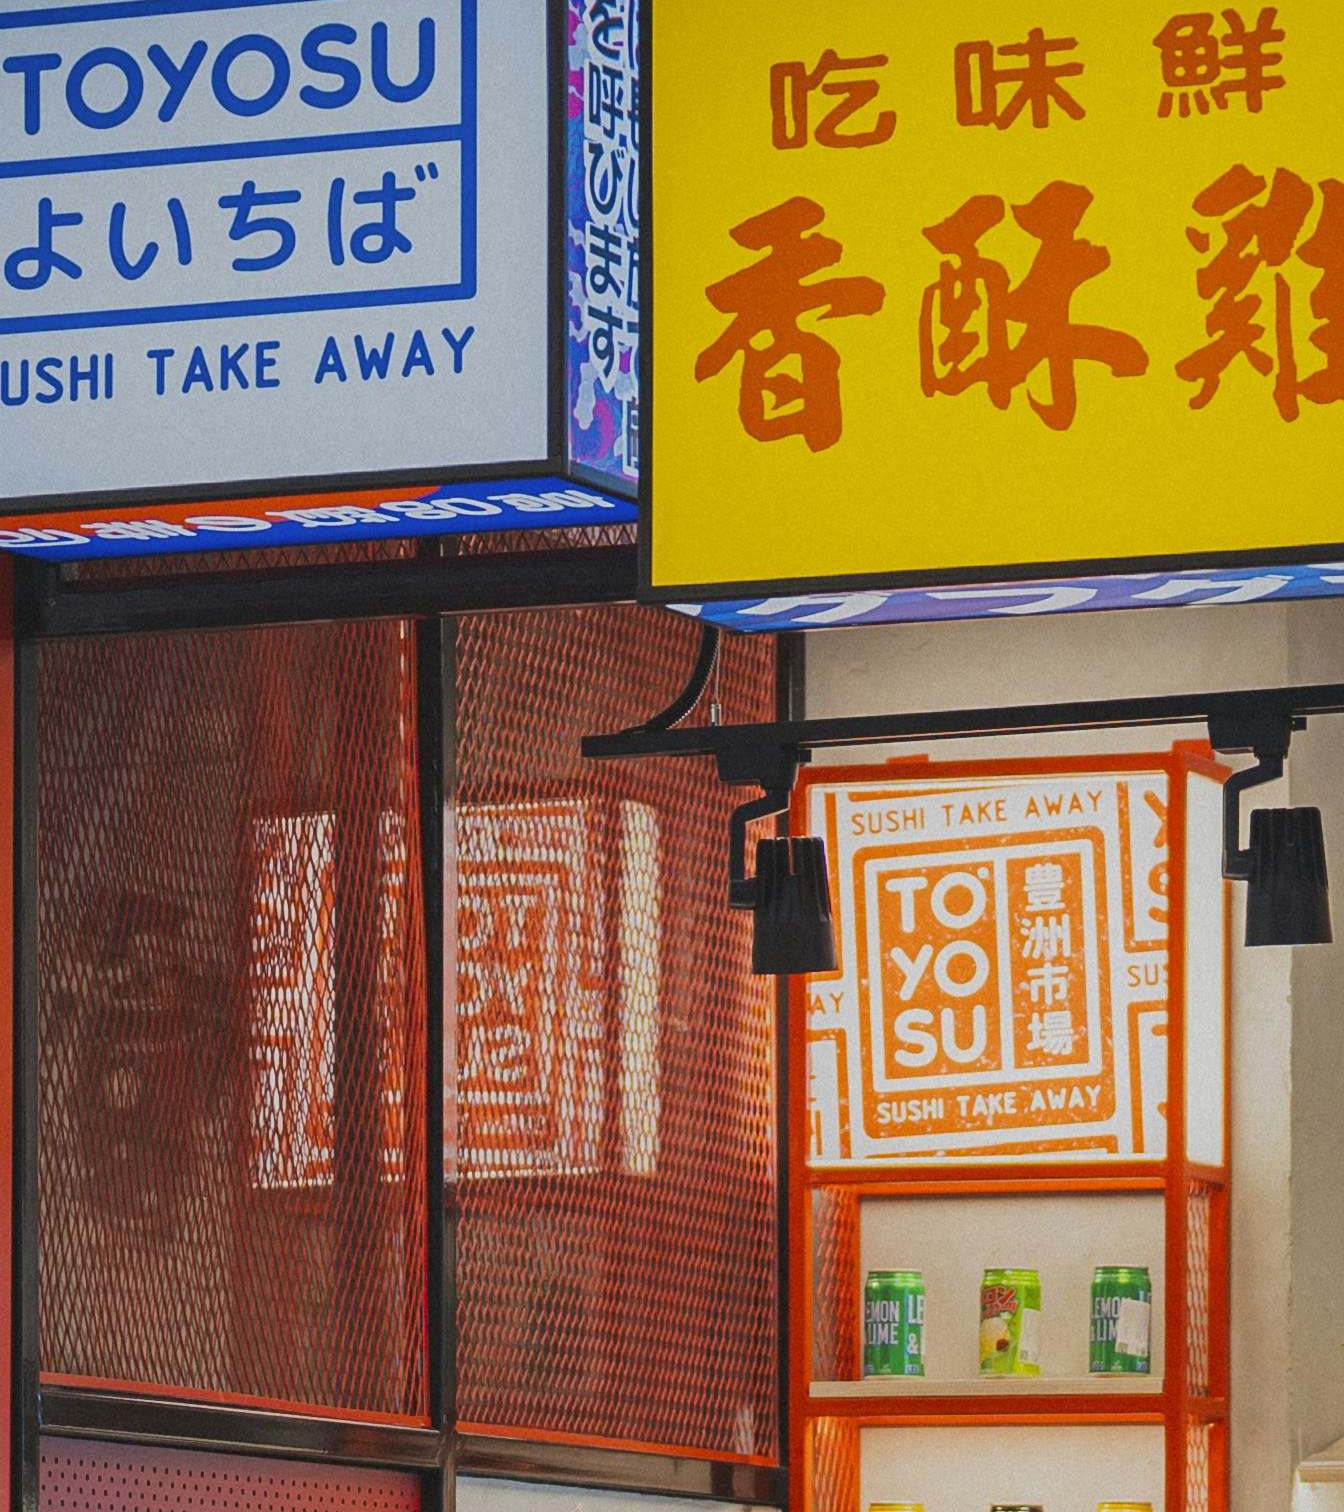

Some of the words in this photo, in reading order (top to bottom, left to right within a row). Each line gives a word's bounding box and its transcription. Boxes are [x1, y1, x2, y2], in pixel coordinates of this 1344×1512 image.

[2, 16, 436, 136] TOYOSU
[769, 7, 1289, 151] 吃味鮮
[3, 161, 439, 291] よいちば
[147, 340, 281, 396] TAKE
[314, 325, 476, 386] AWAY
[850, 808, 925, 837] SUSHI
[942, 799, 1008, 826] TAKE
[1025, 790, 1103, 819] AWAY
[885, 871, 987, 934] TO
[889, 939, 990, 1002] YO
[1019, 862, 1076, 1057] 豊洲市場
[893, 1004, 987, 1068] SU
[876, 1097, 945, 1126] SUSHI
[956, 1091, 1017, 1117] TAKE
[1029, 1084, 1102, 1112] AWAY
